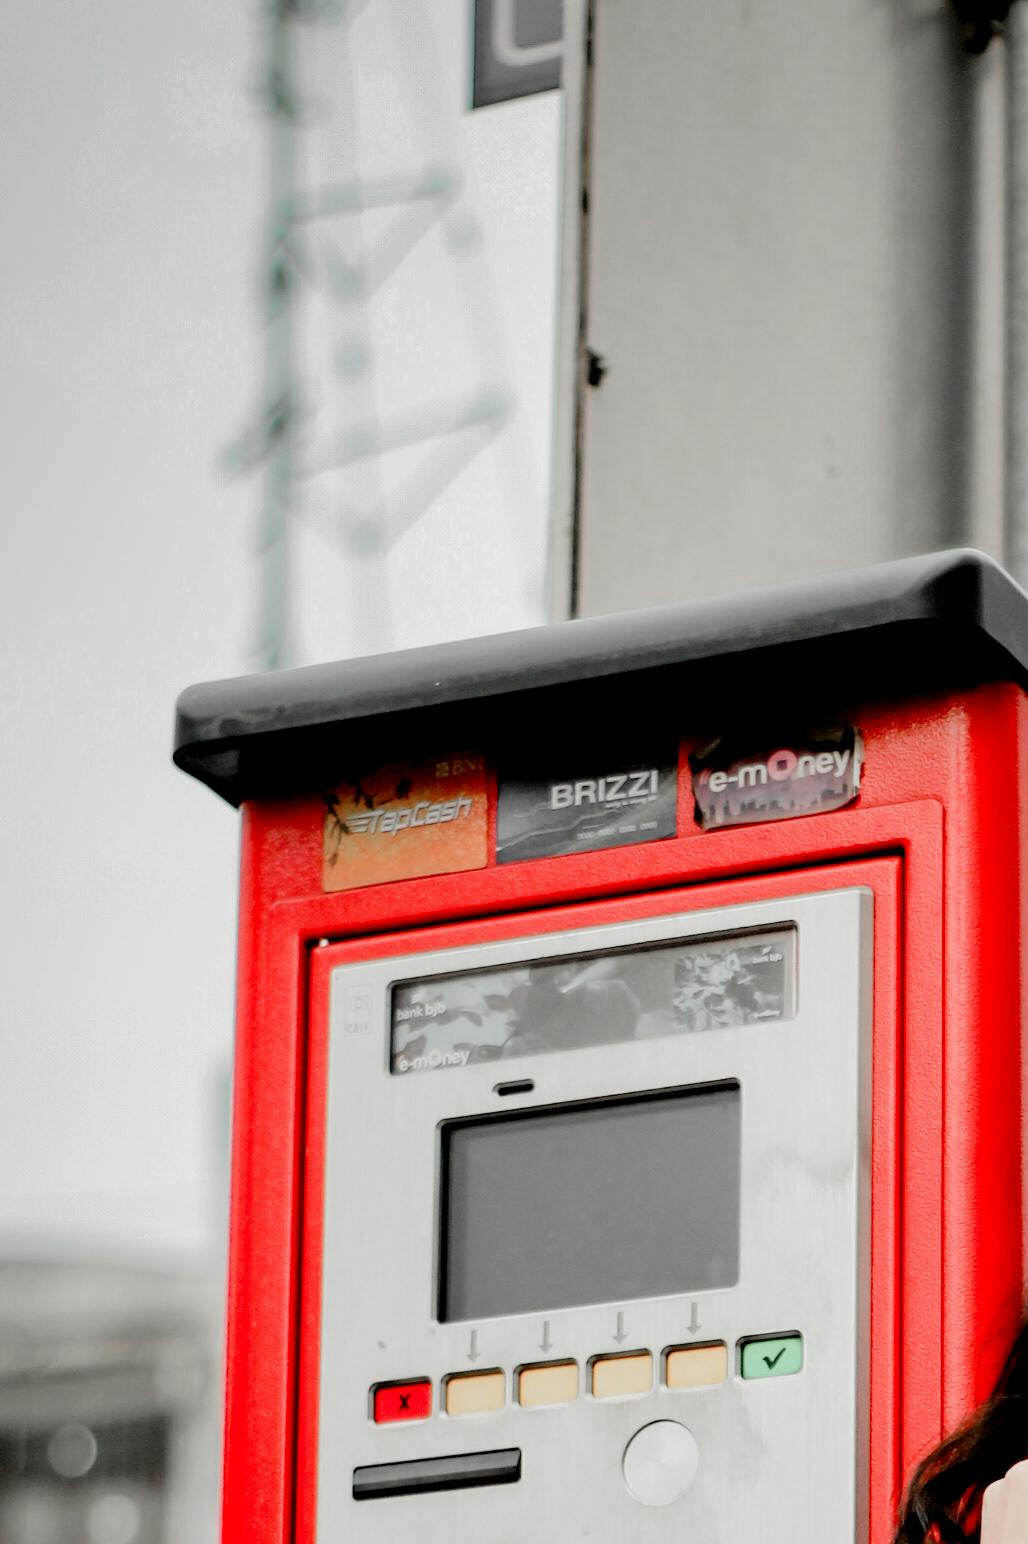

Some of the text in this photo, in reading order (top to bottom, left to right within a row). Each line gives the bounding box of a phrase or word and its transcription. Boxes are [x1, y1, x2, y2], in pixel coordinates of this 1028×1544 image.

[551, 769, 659, 810] BRIZZI
[366, 794, 472, 837] TapCash
[397, 1002, 447, 1021] bank bjb
